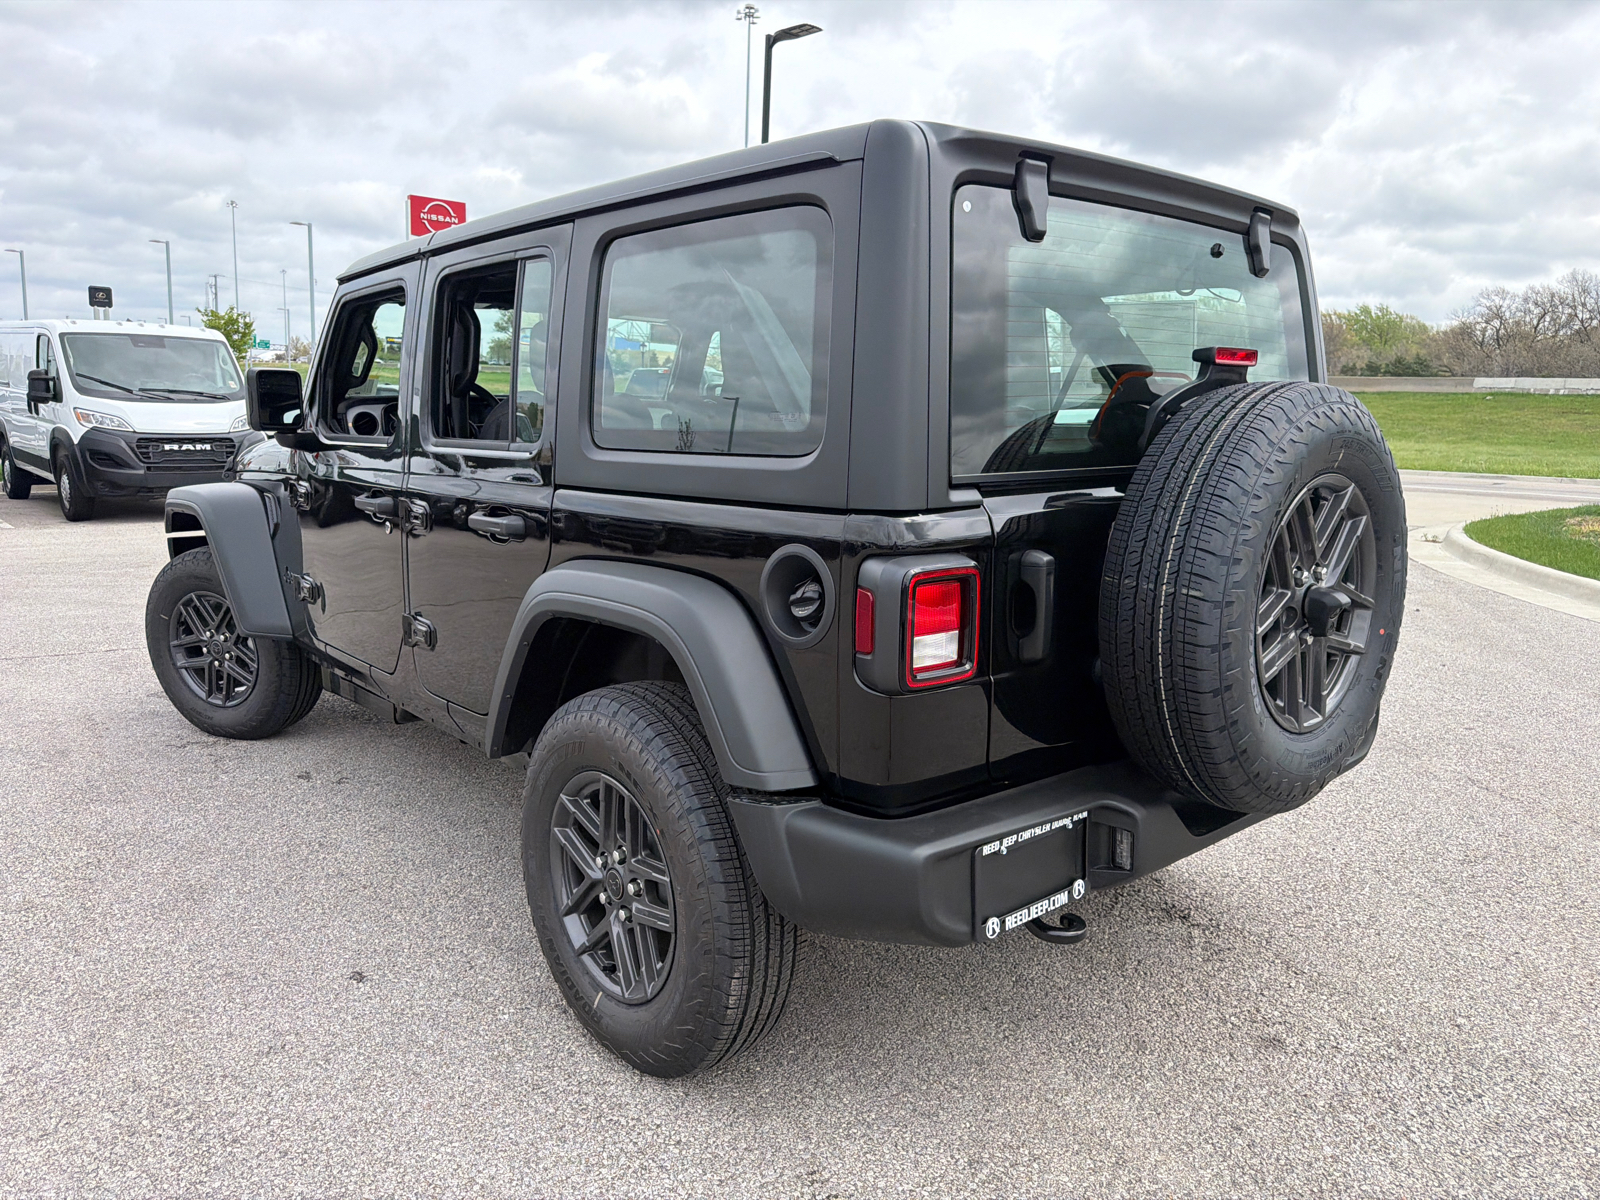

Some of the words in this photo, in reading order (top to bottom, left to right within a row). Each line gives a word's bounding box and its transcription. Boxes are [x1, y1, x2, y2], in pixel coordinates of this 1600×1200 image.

[420, 212, 459, 224] NISSAN
[982, 841, 1000, 856] REED
[1001, 834, 1017, 849] JEEP
[1018, 822, 1051, 842] CHRYSLER
[1073, 811, 1088, 822] RAM
[1005, 890, 1068, 931] REEDJEEP.COM
